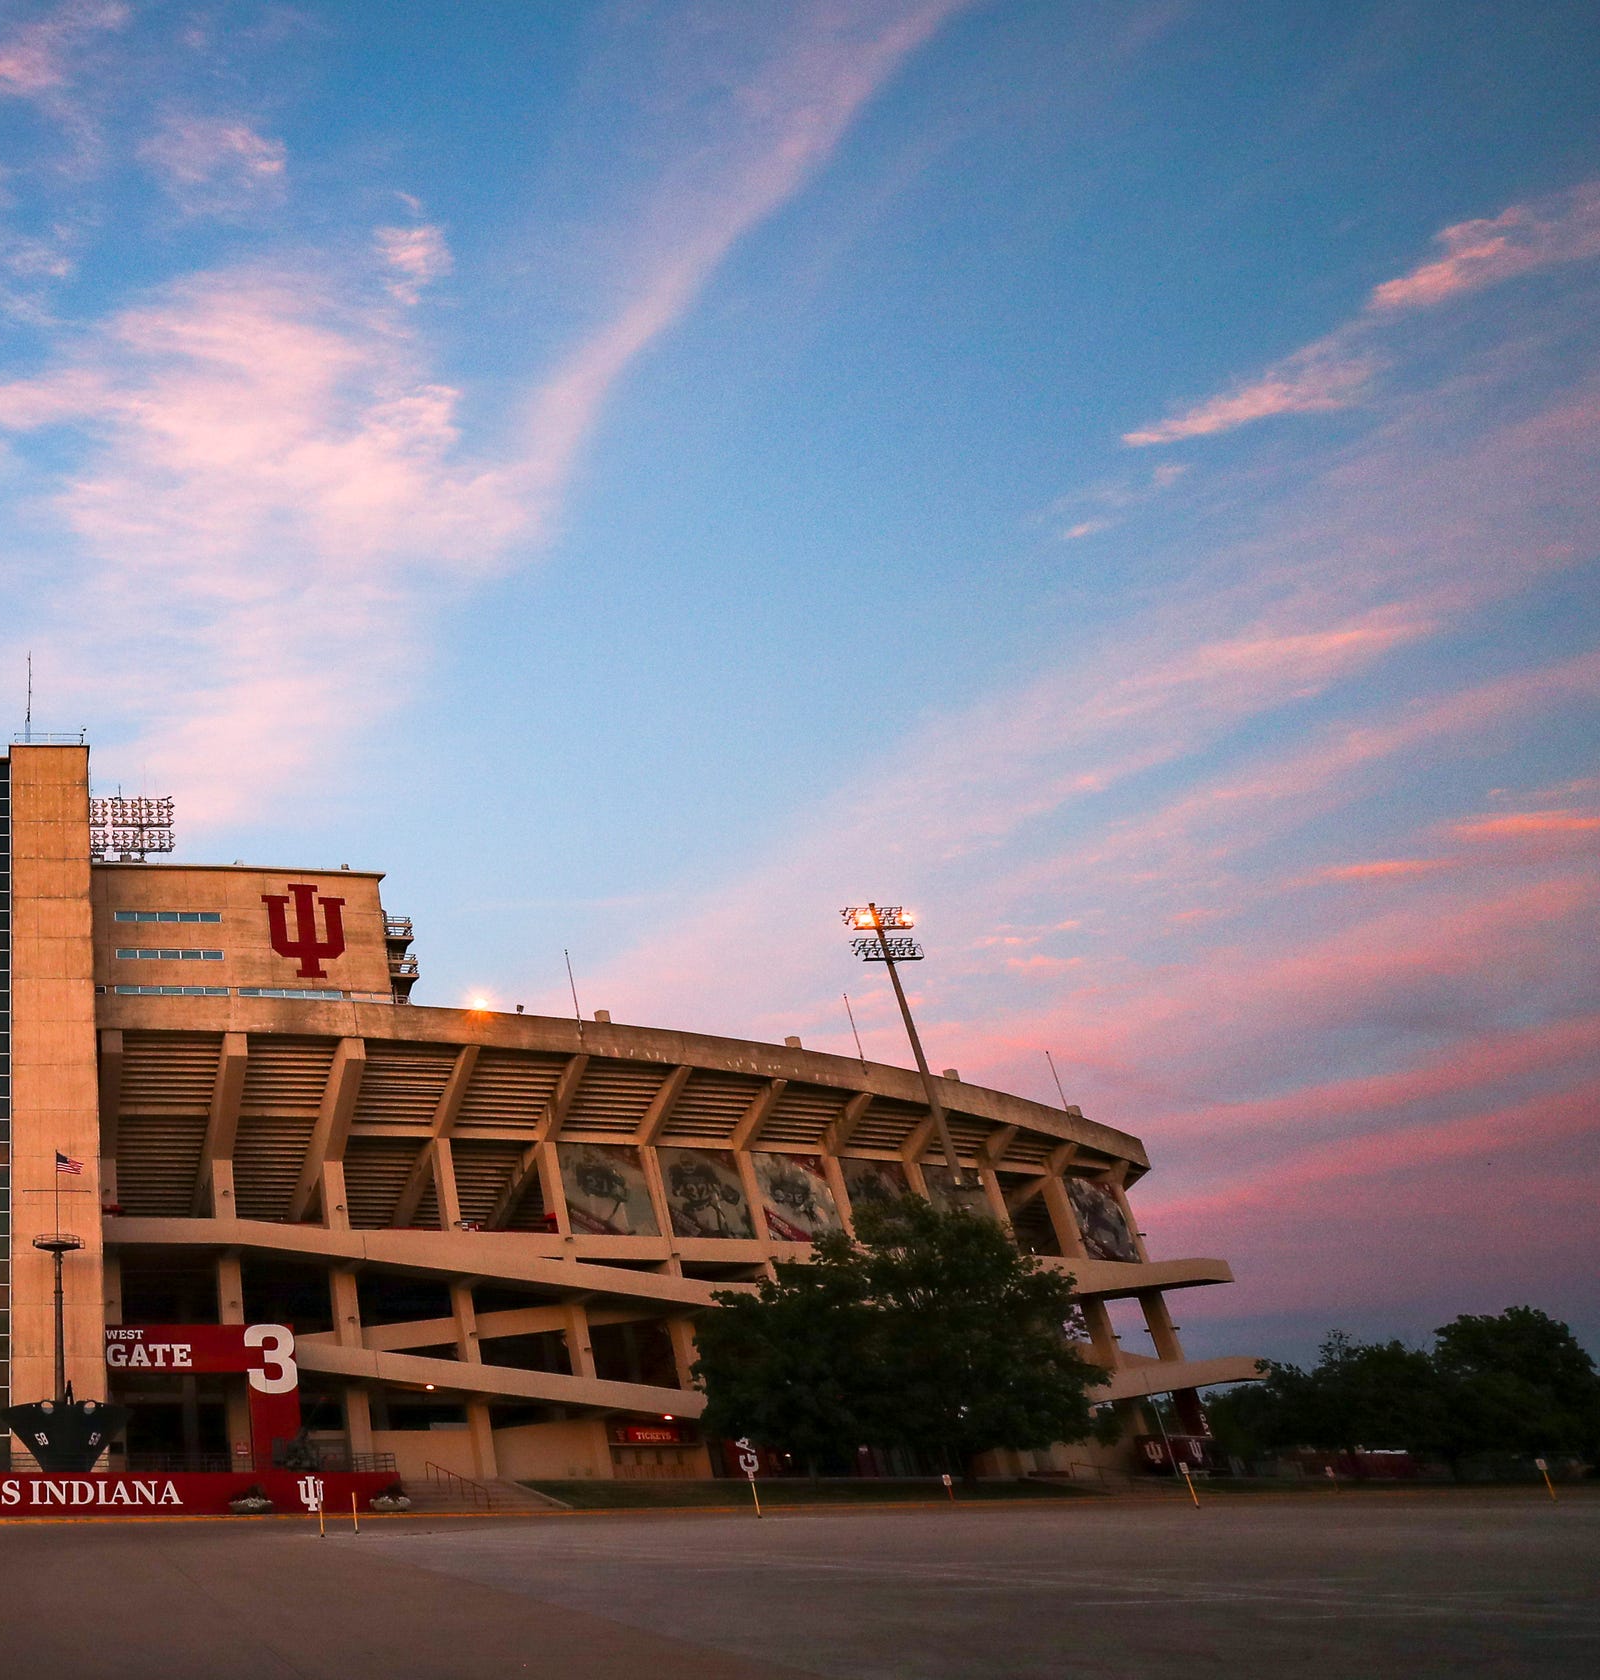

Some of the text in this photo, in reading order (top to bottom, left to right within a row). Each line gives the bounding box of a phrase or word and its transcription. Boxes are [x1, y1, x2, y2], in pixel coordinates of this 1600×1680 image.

[105, 1330, 144, 1339] WEST
[106, 1344, 193, 1367] GATE
[244, 1324, 298, 1394] 3
[34, 1432, 49, 1446] 58
[29, 1480, 184, 1505] INDIANA
